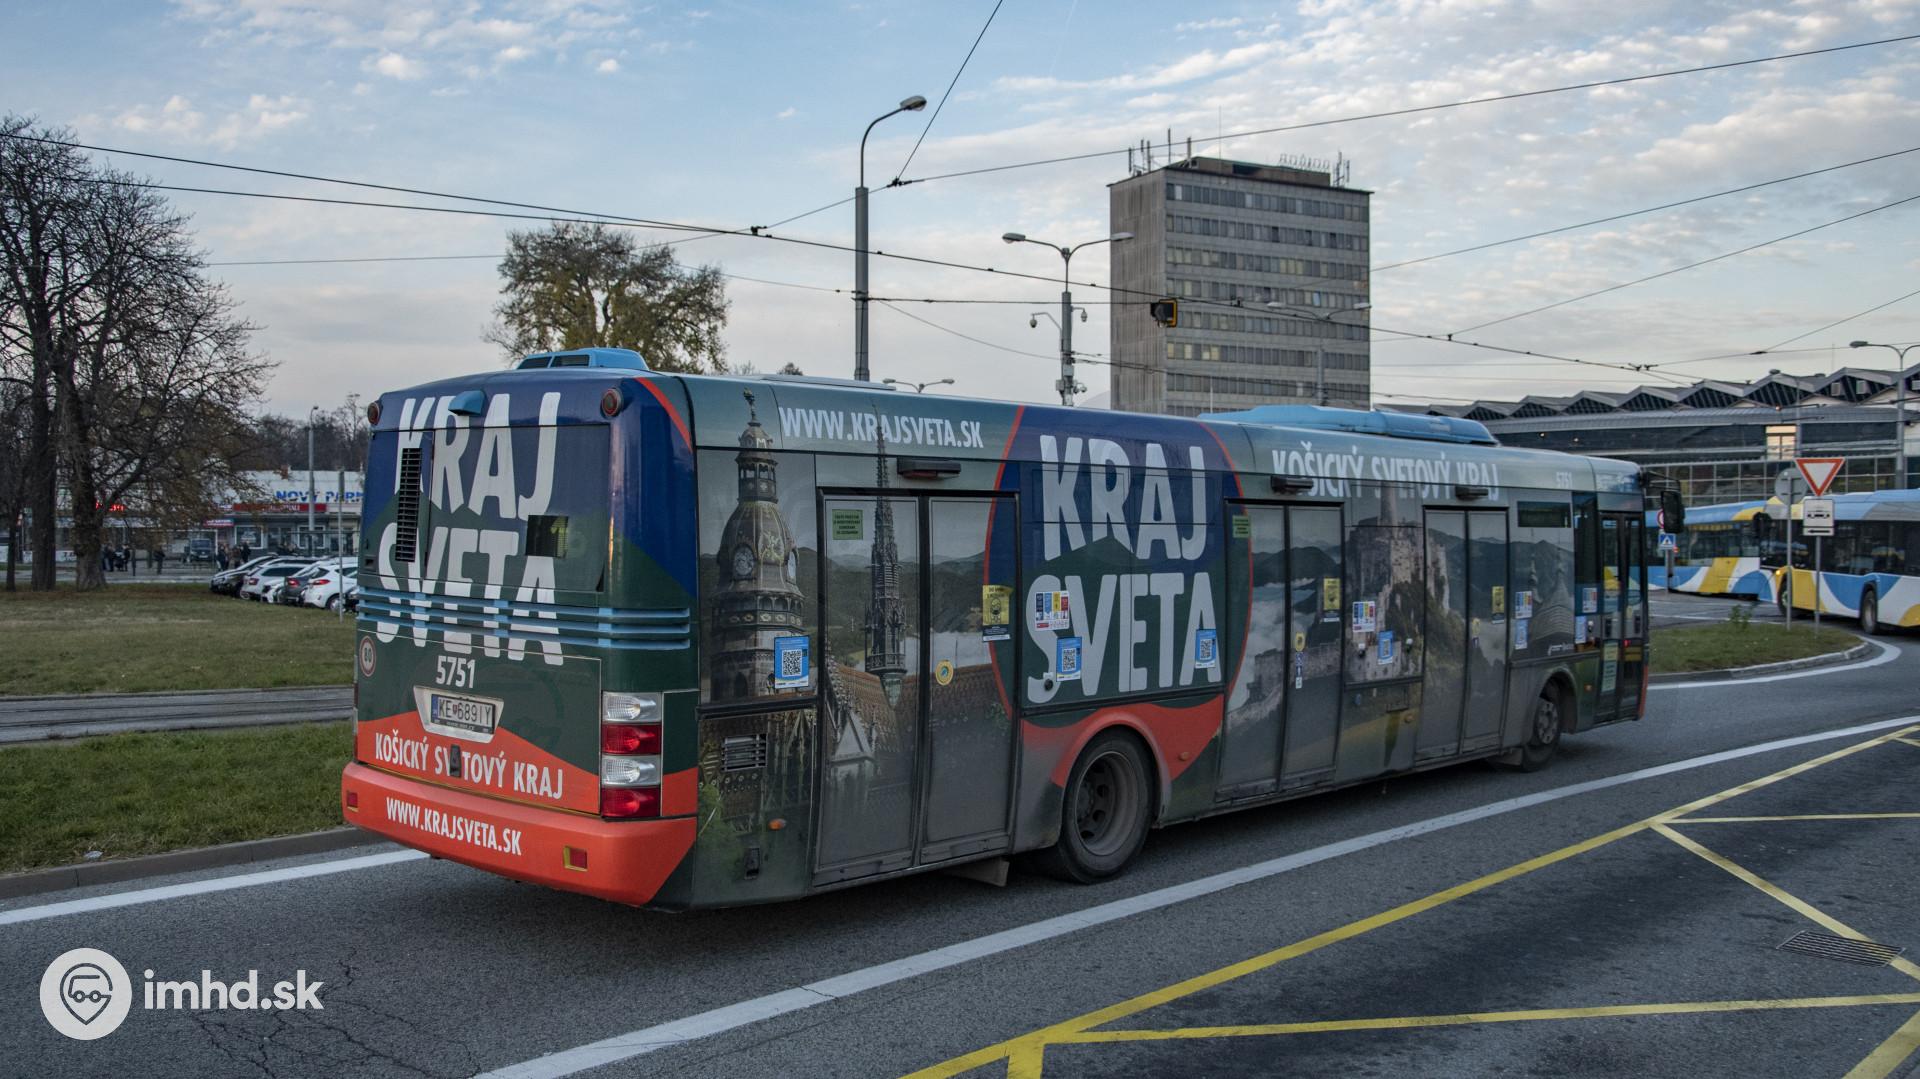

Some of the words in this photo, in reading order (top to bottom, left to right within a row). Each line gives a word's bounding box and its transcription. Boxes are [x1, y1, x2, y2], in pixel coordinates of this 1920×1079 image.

[394, 392, 561, 522] KRAJ
[778, 406, 984, 449] WWW.KRAJSVETA.SK
[1040, 435, 1207, 561] KRAJ
[1271, 440, 1364, 498] KOŠICKÝ
[1371, 450, 1451, 500] SVETOVÝ
[1456, 461, 1499, 501] KRAJ
[376, 523, 564, 666] SVETA
[435, 655, 476, 689] 5751
[1026, 572, 1222, 703] SVETA
[375, 729, 429, 771] KOŠICKÝ
[434, 745, 506, 788] SVTOVÝ
[513, 761, 564, 800] KRAJ
[386, 796, 522, 856] WWW.KRAJSVETA.SK
